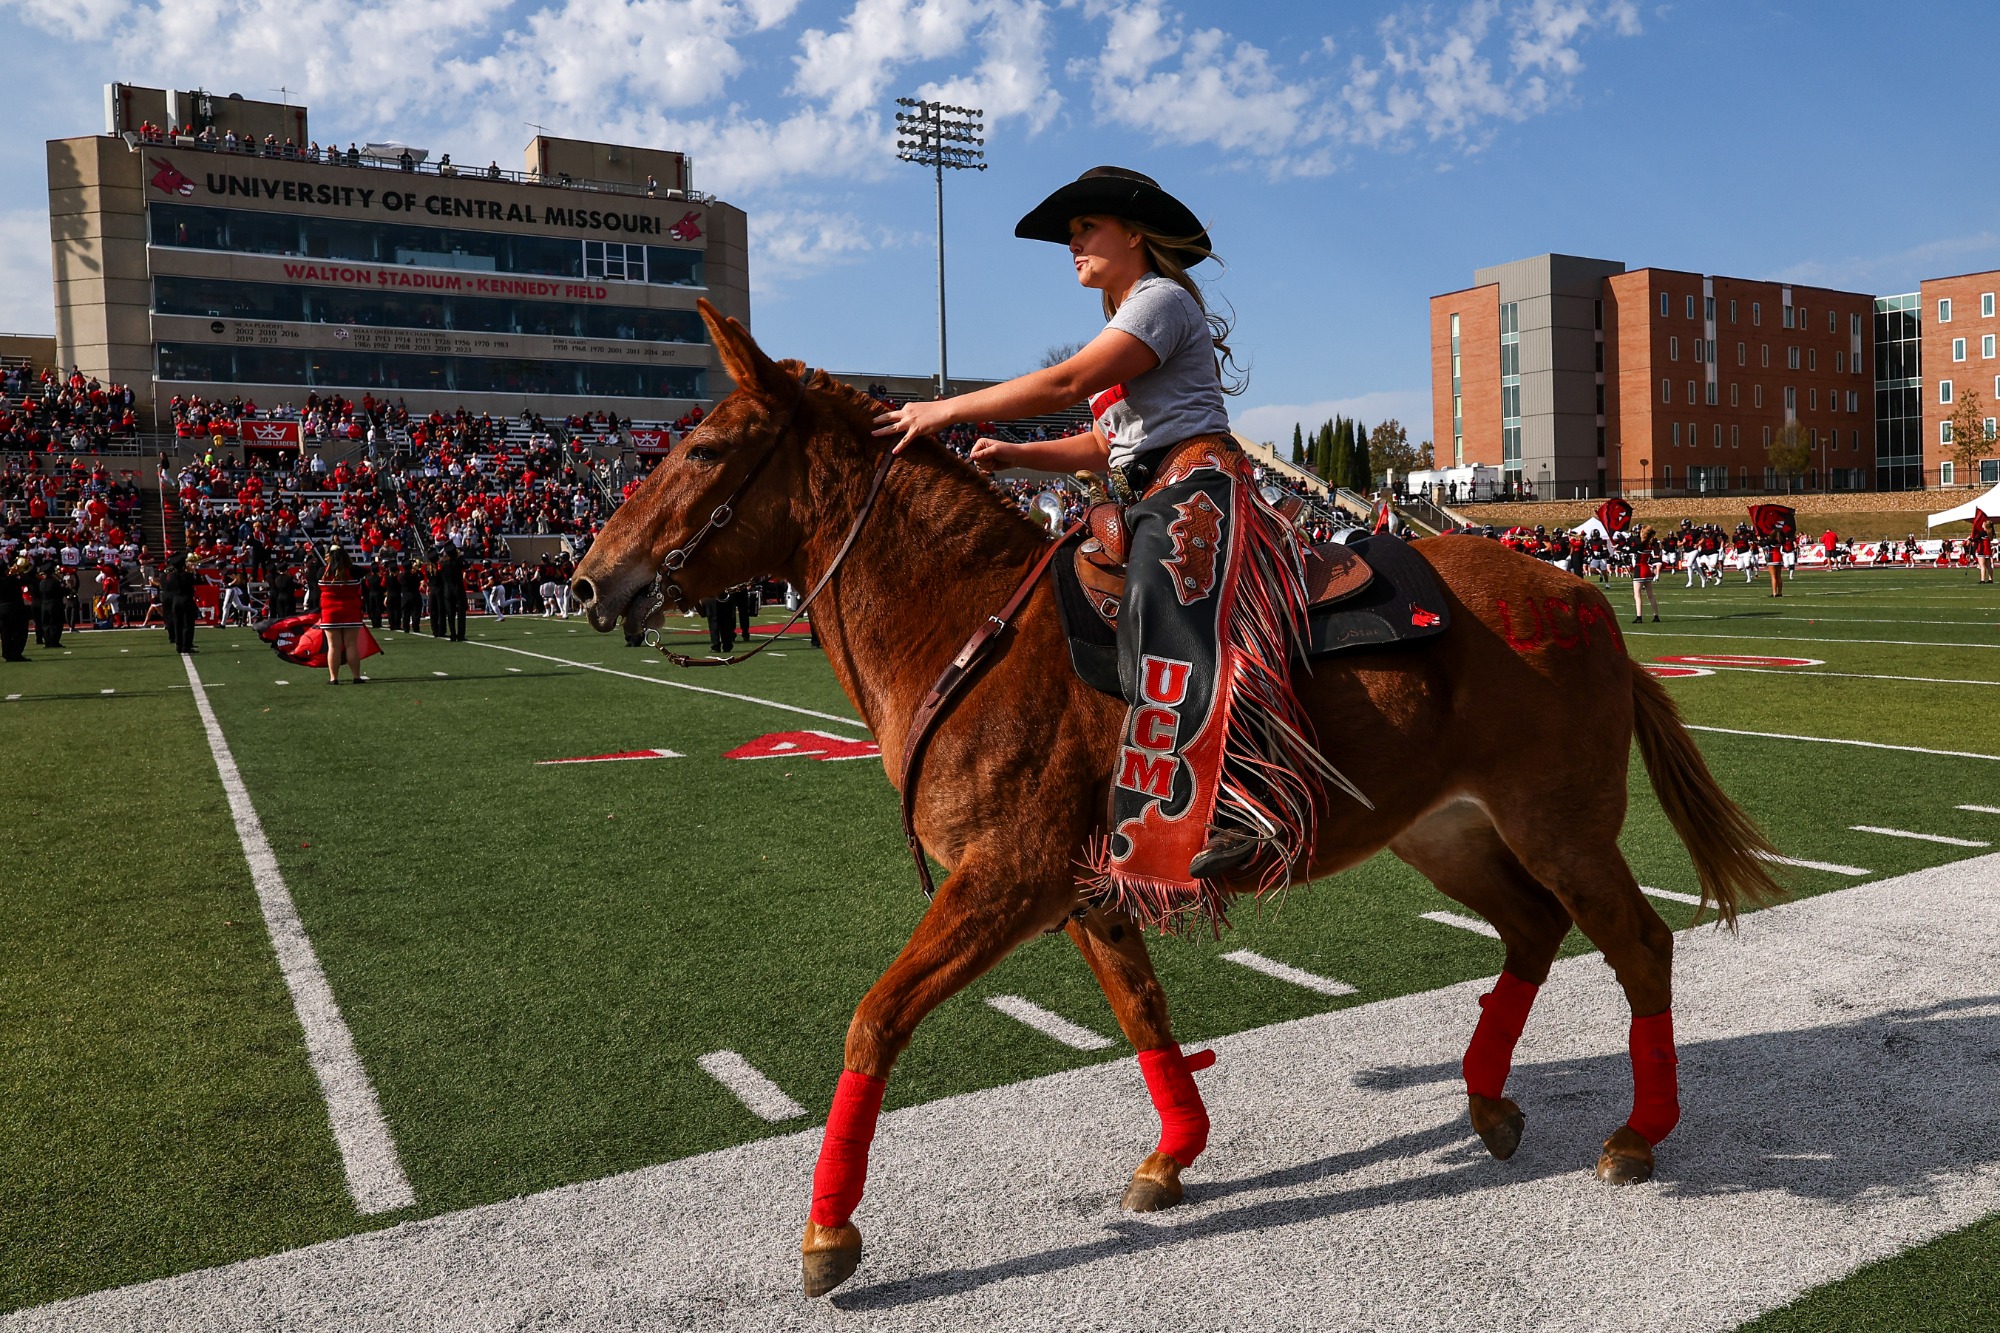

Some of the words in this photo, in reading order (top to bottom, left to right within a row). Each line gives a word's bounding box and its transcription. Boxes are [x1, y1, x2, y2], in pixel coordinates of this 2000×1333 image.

[206, 172, 374, 208] UNIVERSITY
[381, 191, 416, 212] OF
[424, 195, 537, 224] CENTRAL
[544, 206, 662, 235] MISSOURI
[283, 263, 372, 284] WALTON
[377, 266, 462, 290] STADIUM
[476, 278, 561, 297] KENNEDY
[565, 284, 608, 300] FIELD
[235, 328, 254, 336] 2002
[258, 329, 277, 337] 2010
[280, 330, 300, 338] 2016
[235, 335, 254, 343] 2019
[259, 336, 278, 344] 2023
[353, 334, 370, 342] 1912
[394, 336, 411, 344] 1914
[434, 338, 451, 346] 1926
[474, 340, 490, 348] 1970
[493, 341, 509, 349] 1983
[353, 341, 371, 349] 1986
[373, 342, 390, 350] 1987
[393, 343, 411, 351] 1988
[243, 439, 272, 447] COLLISION
[1497, 597, 1623, 655] UCM
[1115, 654, 1193, 802] UCM
